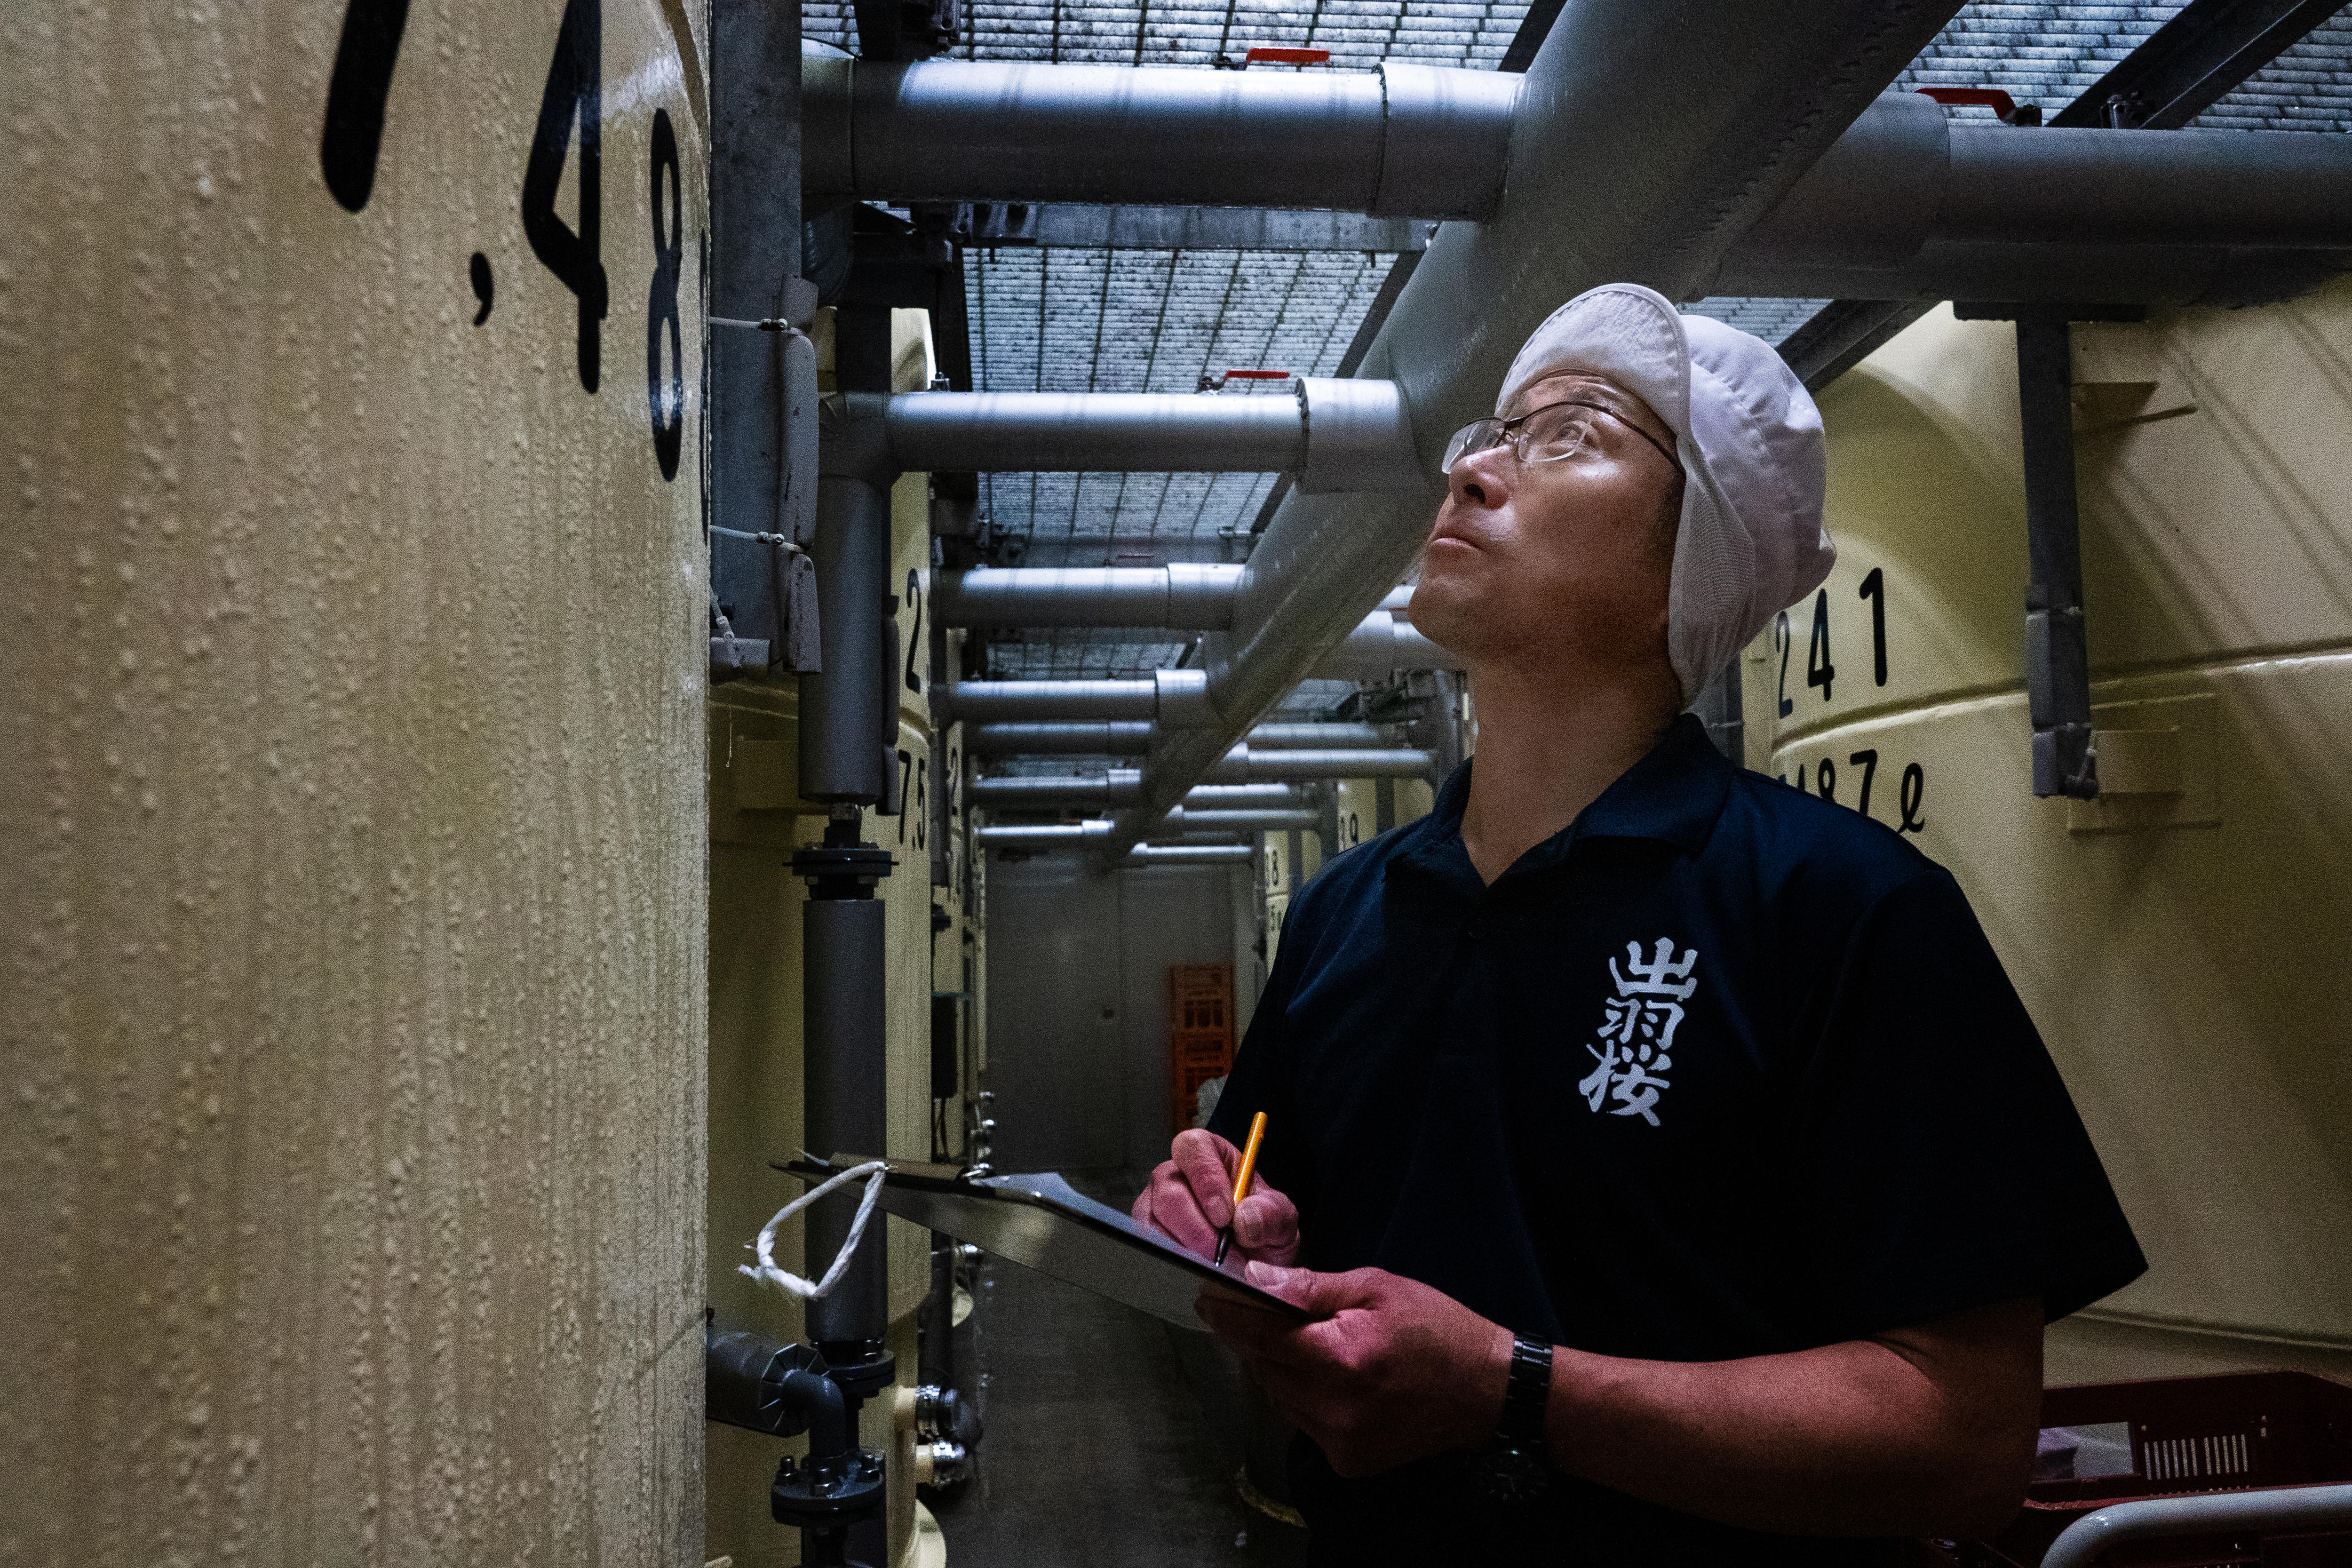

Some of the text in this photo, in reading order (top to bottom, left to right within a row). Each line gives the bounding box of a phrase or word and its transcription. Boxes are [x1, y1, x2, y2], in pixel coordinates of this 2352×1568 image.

[1776, 567, 1888, 719] 241
[1579, 936, 1699, 1127] 出羽桜
